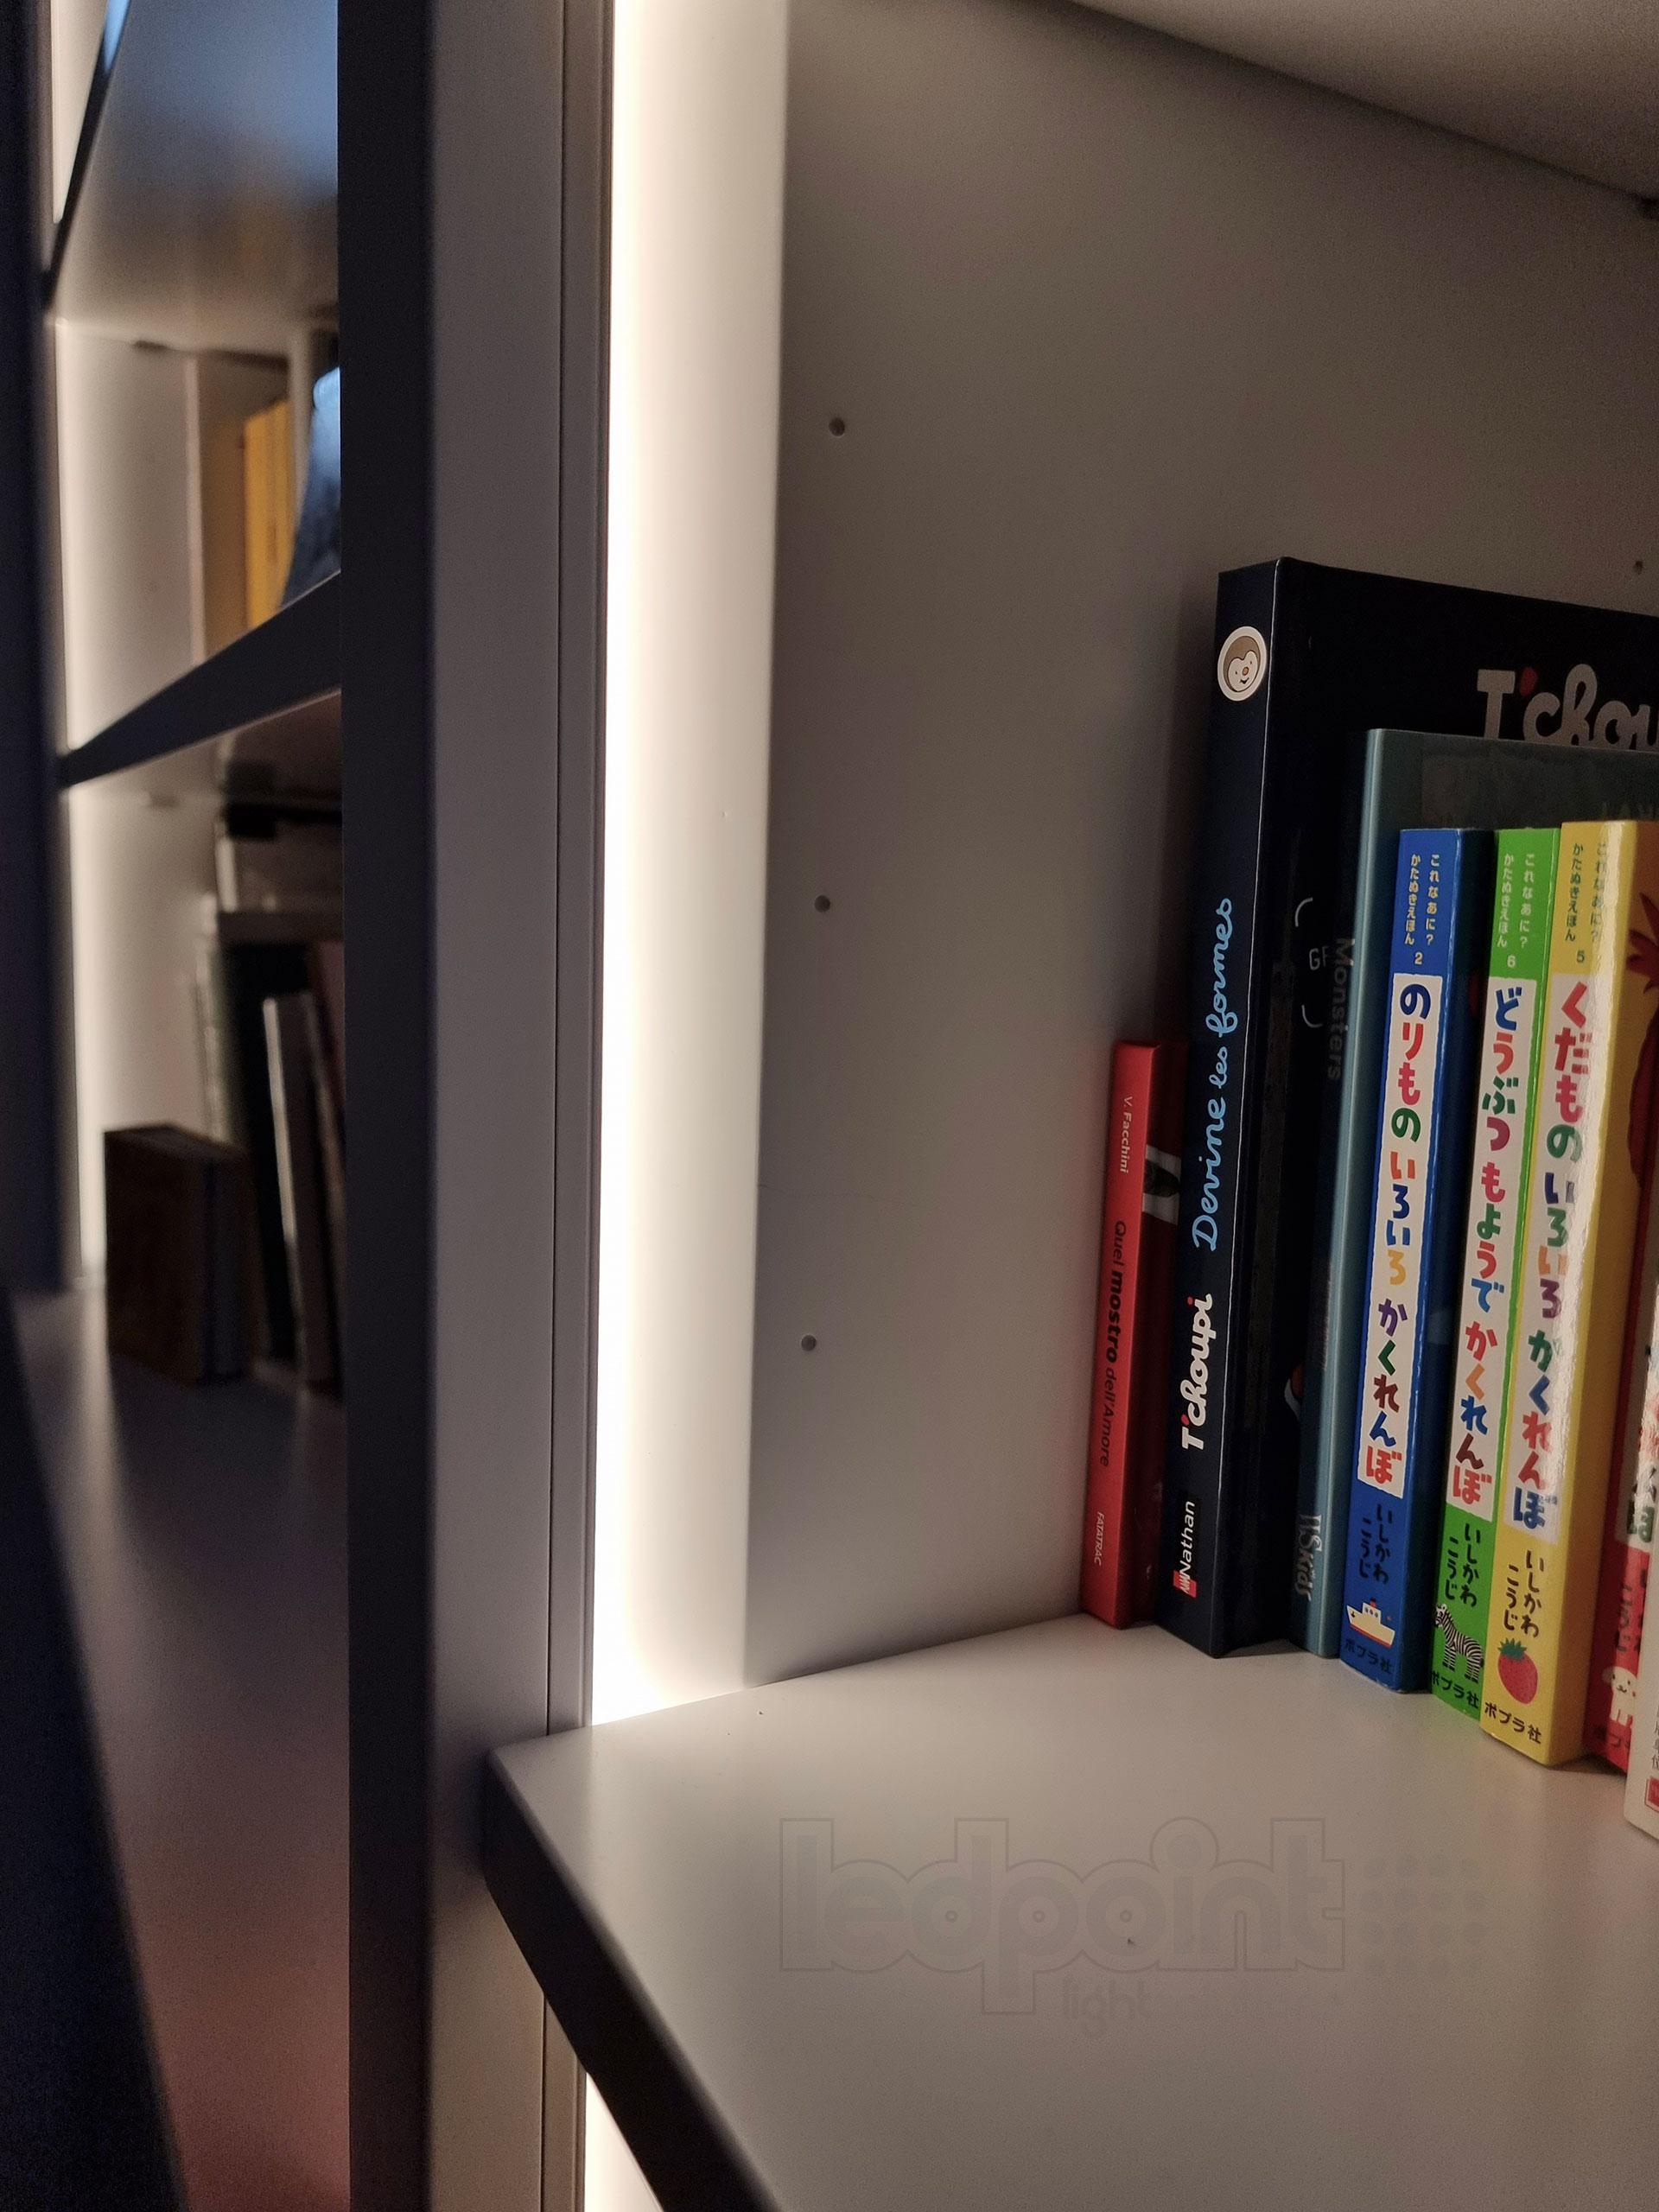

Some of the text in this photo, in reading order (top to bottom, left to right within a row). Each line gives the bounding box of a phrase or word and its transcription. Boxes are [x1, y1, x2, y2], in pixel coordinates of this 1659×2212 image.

[1404, 854, 1421, 946] かたぬきえほん
[1497, 854, 1515, 949] かたぬきえほん
[1566, 843, 1583, 942] かたぬきえほん
[1414, 952, 1423, 966] 2
[1507, 956, 1516, 969] 6
[1576, 950, 1586, 963] 5
[1192, 898, 1238, 1252] Devine les formes
[1120, 1096, 1133, 1173] V. Facchini
[1100, 1220, 1126, 1467] Quel mostro dell'Amore
[1180, 1294, 1217, 1450] T'choupi
[1094, 1511, 1105, 1566] FATATRAC
[1179, 1501, 1195, 1580] Nathan
[1358, 1517, 1372, 1579] こうじ
[1373, 1503, 1393, 1585] いしかわ
[1445, 1536, 1459, 1600] こうじ
[1460, 1523, 1481, 1607] いしかわ
[1503, 1564, 1519, 1630] こうじ
[1521, 1550, 1545, 1637] いしかわ
[1429, 1670, 1480, 1709] ポプラ社
[1484, 1702, 1541, 1745] ポプラ社
